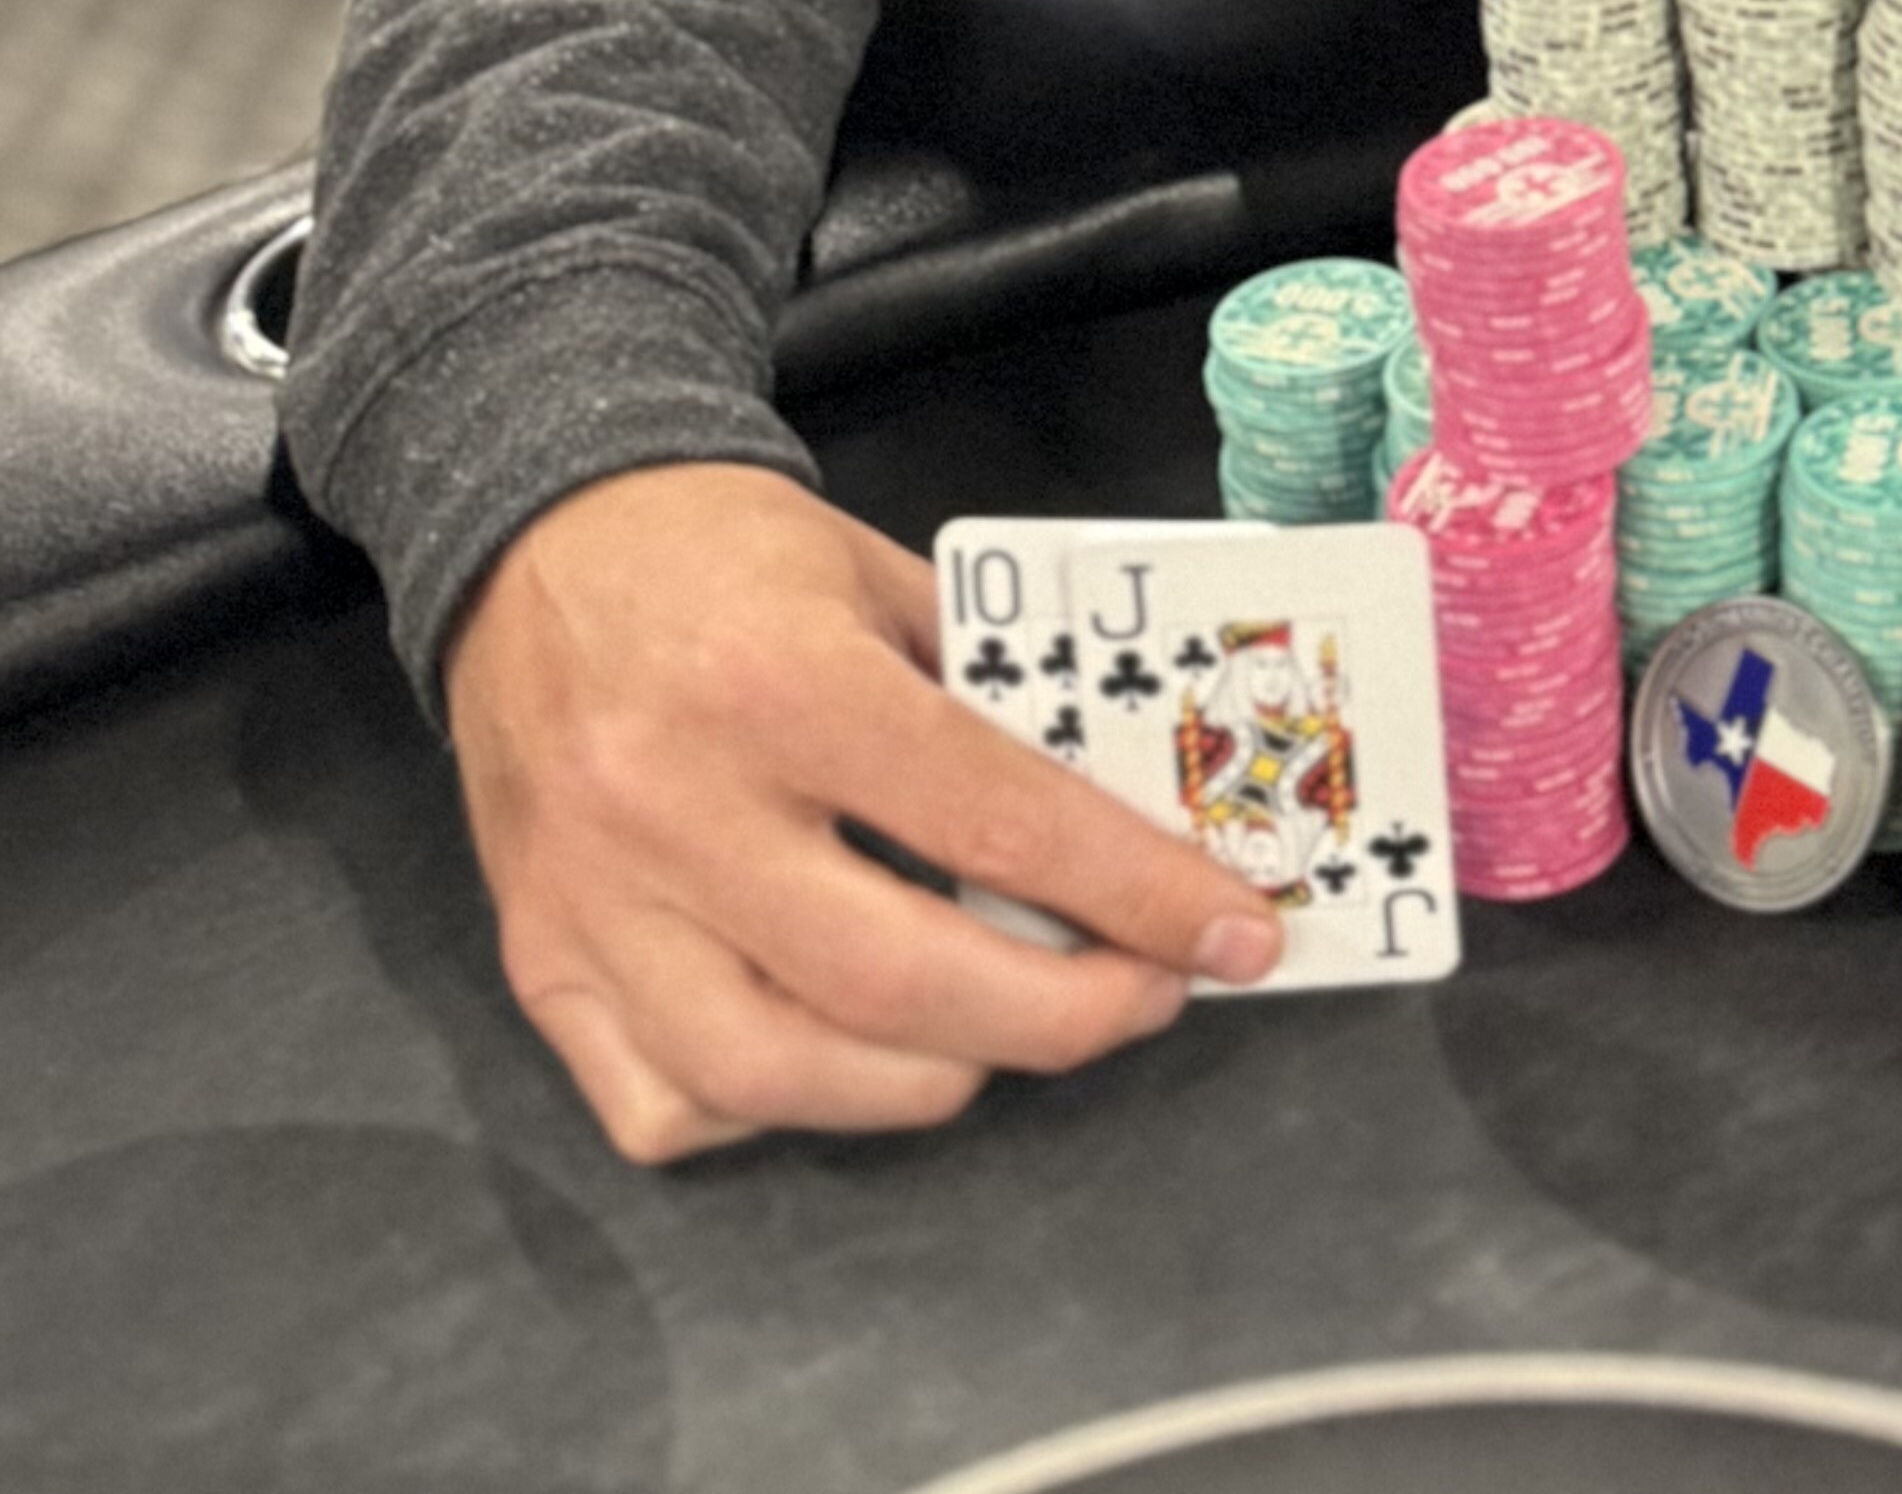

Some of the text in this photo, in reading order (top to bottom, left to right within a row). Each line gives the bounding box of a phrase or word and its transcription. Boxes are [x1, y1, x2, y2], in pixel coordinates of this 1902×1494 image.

[952, 548, 1022, 627] 10
[1091, 564, 1154, 641] J
[1374, 887, 1437, 960] J
